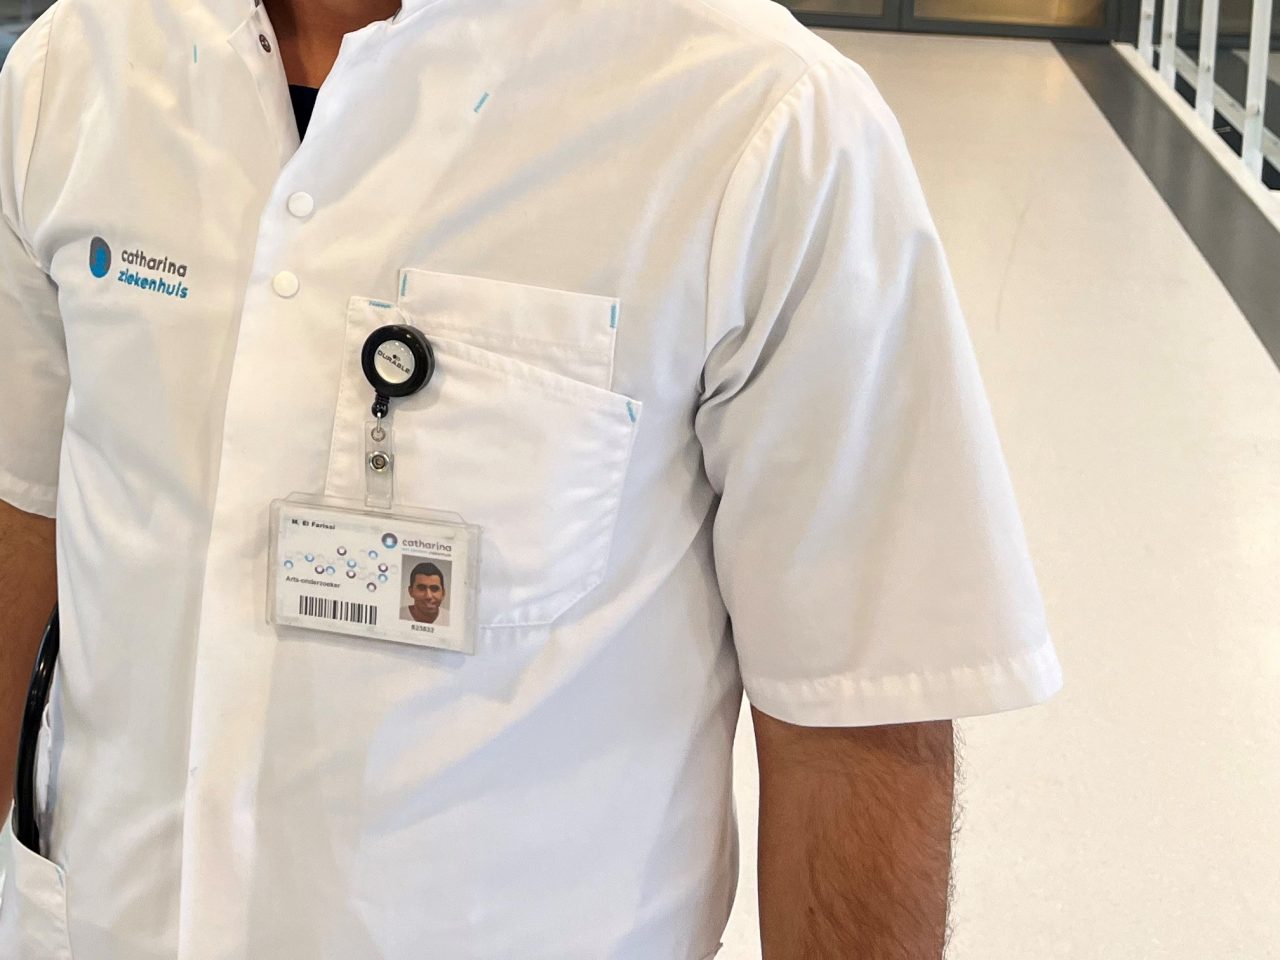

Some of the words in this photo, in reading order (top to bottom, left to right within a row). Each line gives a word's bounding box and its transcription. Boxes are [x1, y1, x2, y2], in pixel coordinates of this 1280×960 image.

[121, 249, 188, 278] catharina
[118, 268, 189, 299] ziekenhuis
[378, 350, 410, 374] DURABLE
[402, 539, 452, 552] catharina
